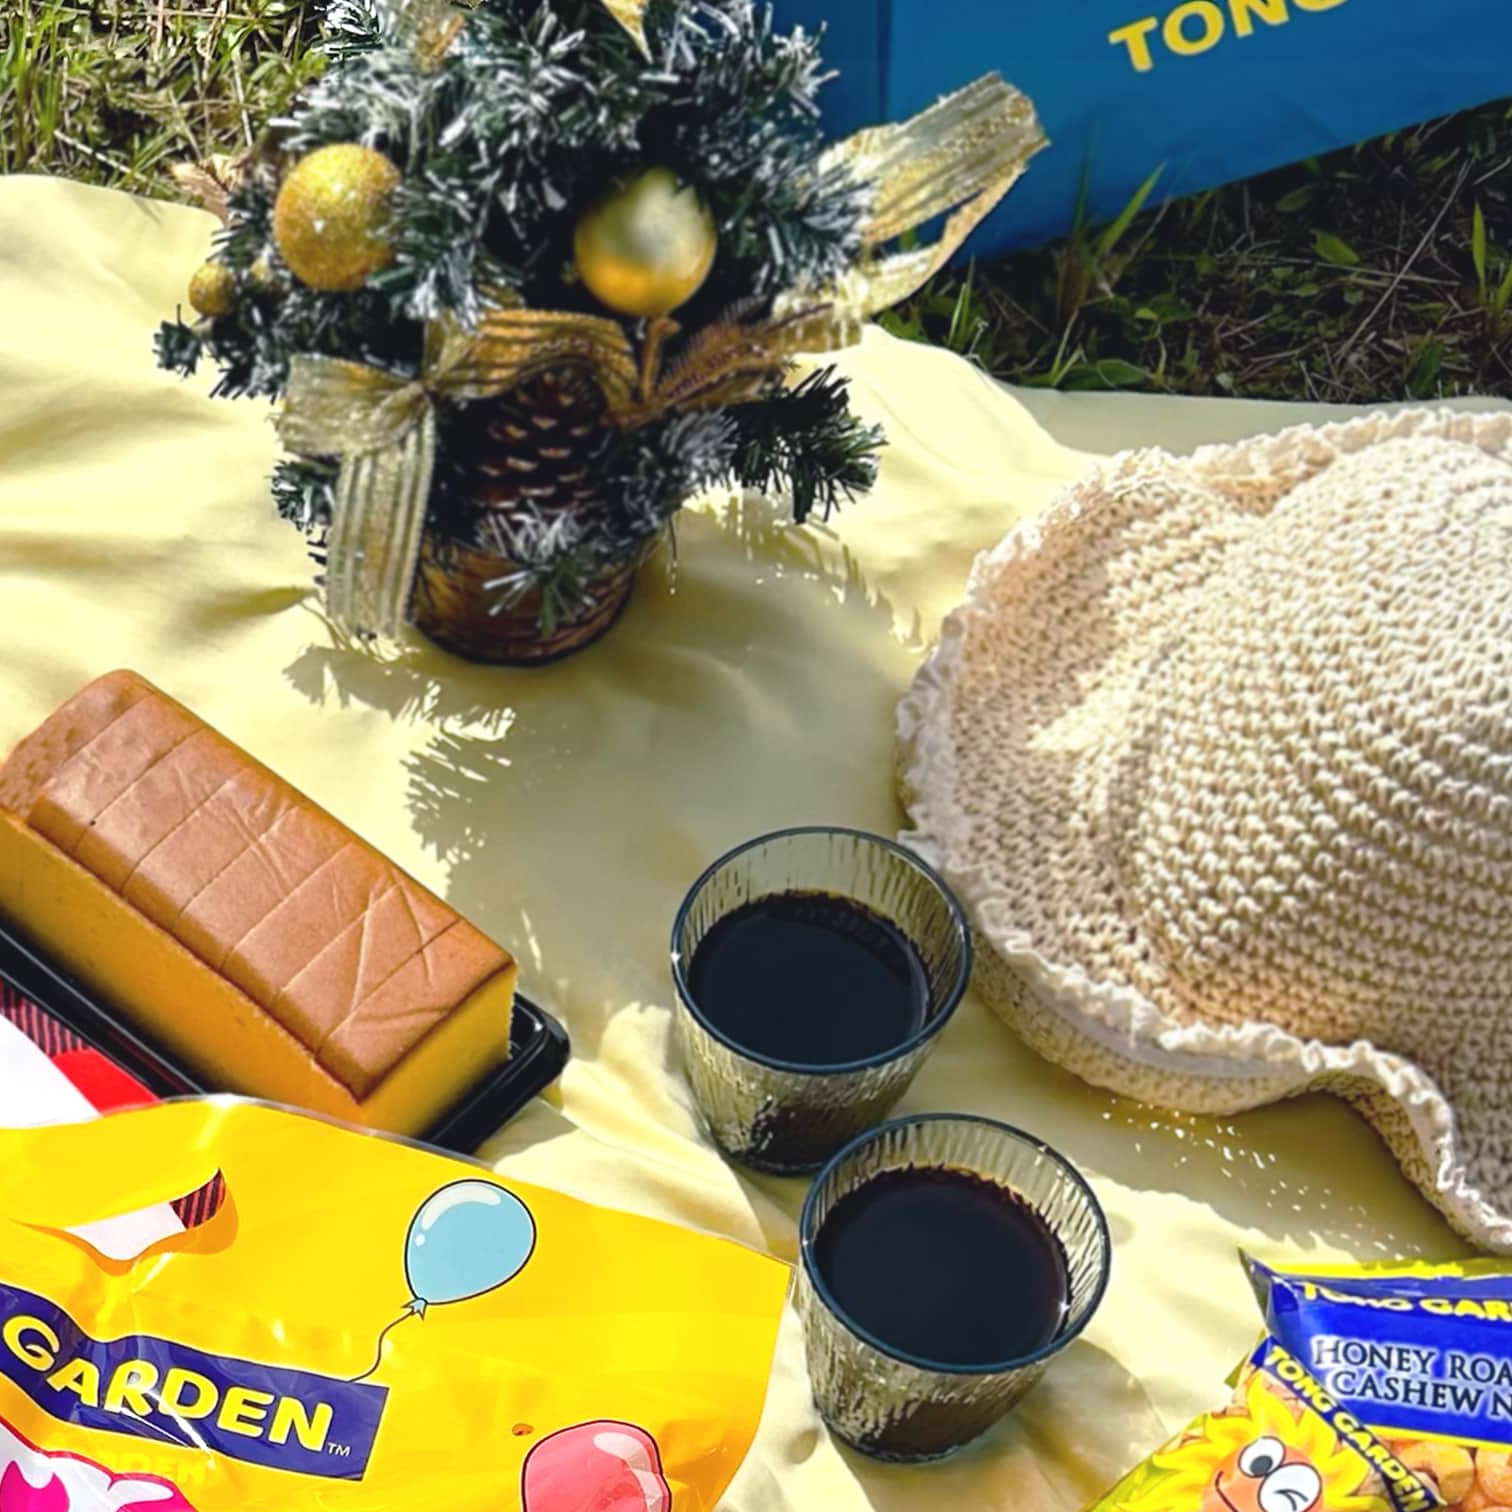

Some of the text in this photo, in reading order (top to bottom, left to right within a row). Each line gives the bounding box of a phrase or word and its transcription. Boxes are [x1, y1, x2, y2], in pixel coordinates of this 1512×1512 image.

[1108, 0, 1352, 73] TON
[2, 1314, 333, 1453] GARDEN
[1314, 1339, 1436, 1376] HONEY
[1264, 1345, 1430, 1512] TONG GARDEN
[1333, 1371, 1485, 1418] CASHEW
